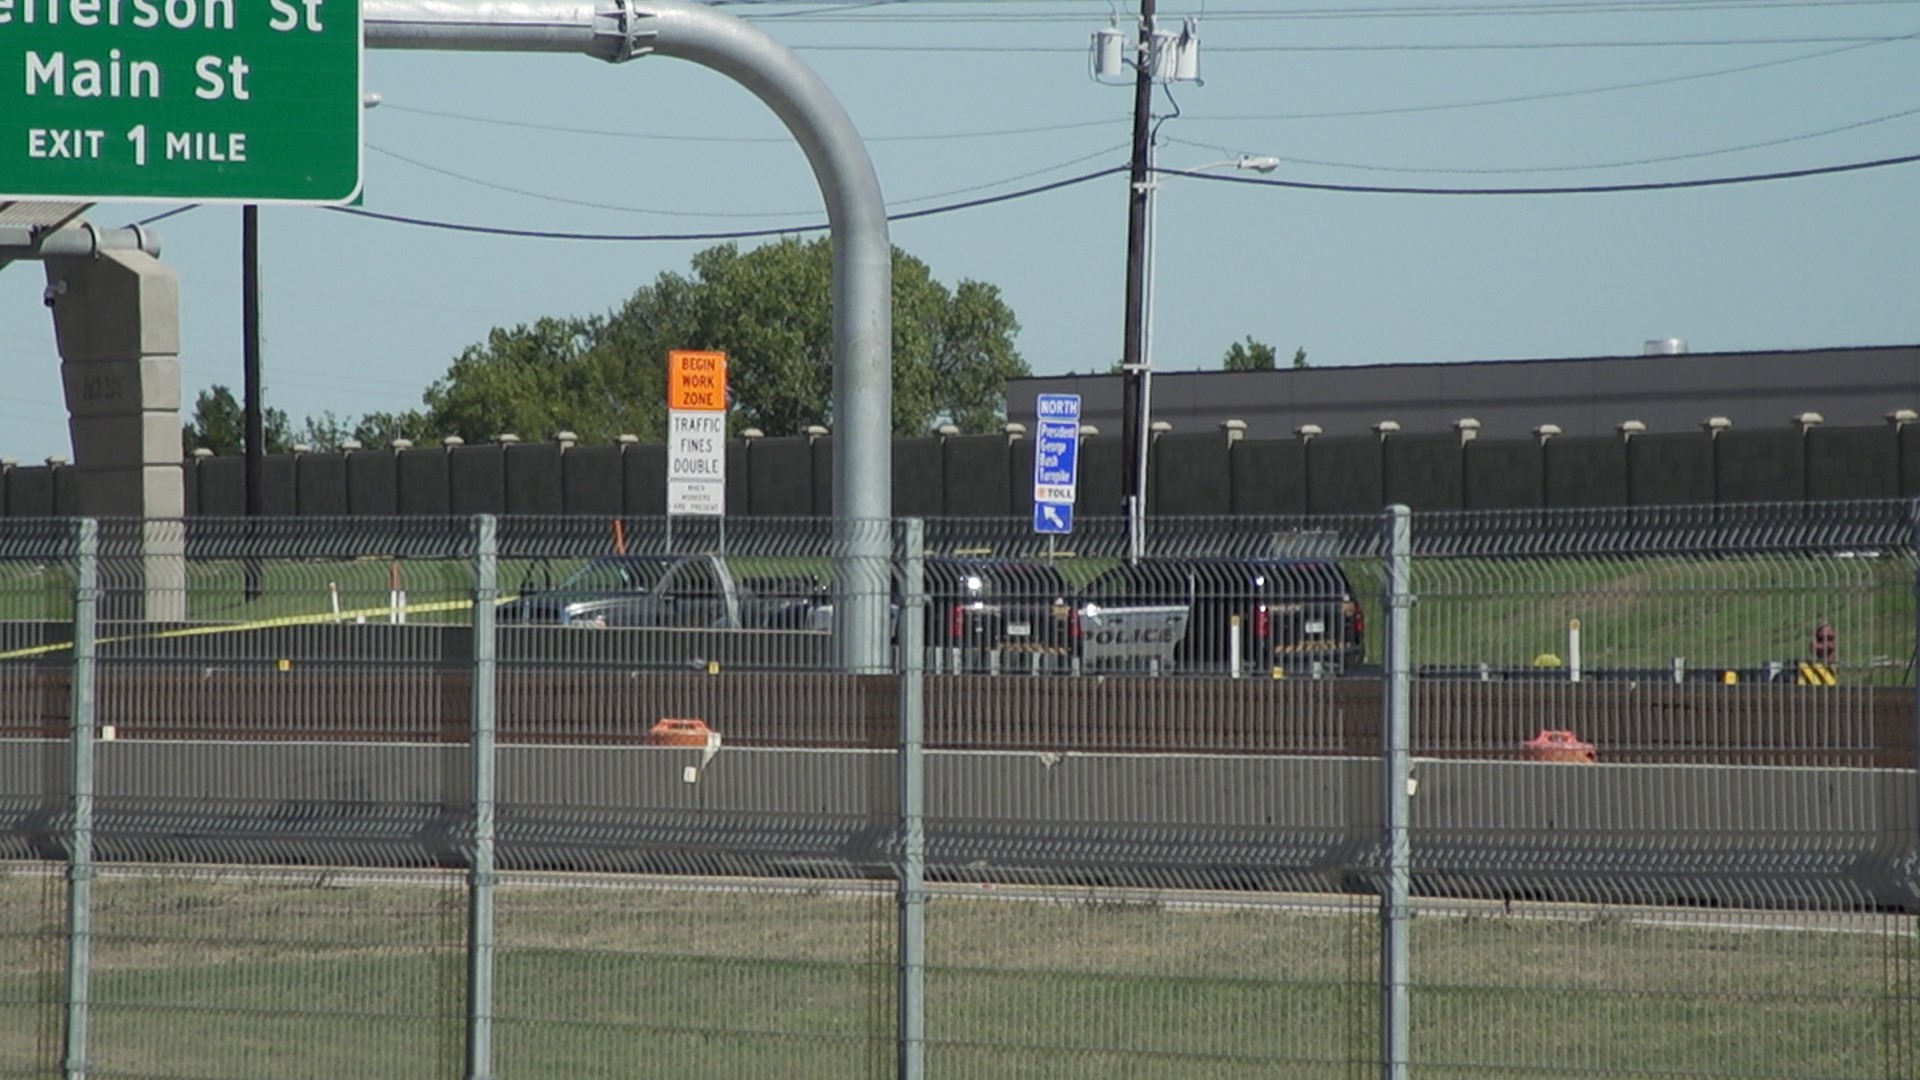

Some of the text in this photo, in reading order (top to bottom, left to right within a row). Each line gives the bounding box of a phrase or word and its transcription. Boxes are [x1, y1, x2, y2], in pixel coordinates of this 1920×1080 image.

[0, 0, 323, 32] erson St
[25, 49, 250, 101] Main St
[28, 124, 247, 166] EXIT 1 MILE
[681, 357, 716, 371] BEGIN
[682, 375, 715, 388] WORK
[682, 392, 714, 406] ZONE
[1040, 400, 1078, 415] NORTH
[674, 417, 721, 433] TRAFFIC
[680, 438, 713, 453] FINES
[673, 458, 719, 474] DOUBLE
[1047, 488, 1073, 499] TOLL
[1084, 628, 1172, 645] POLICE
